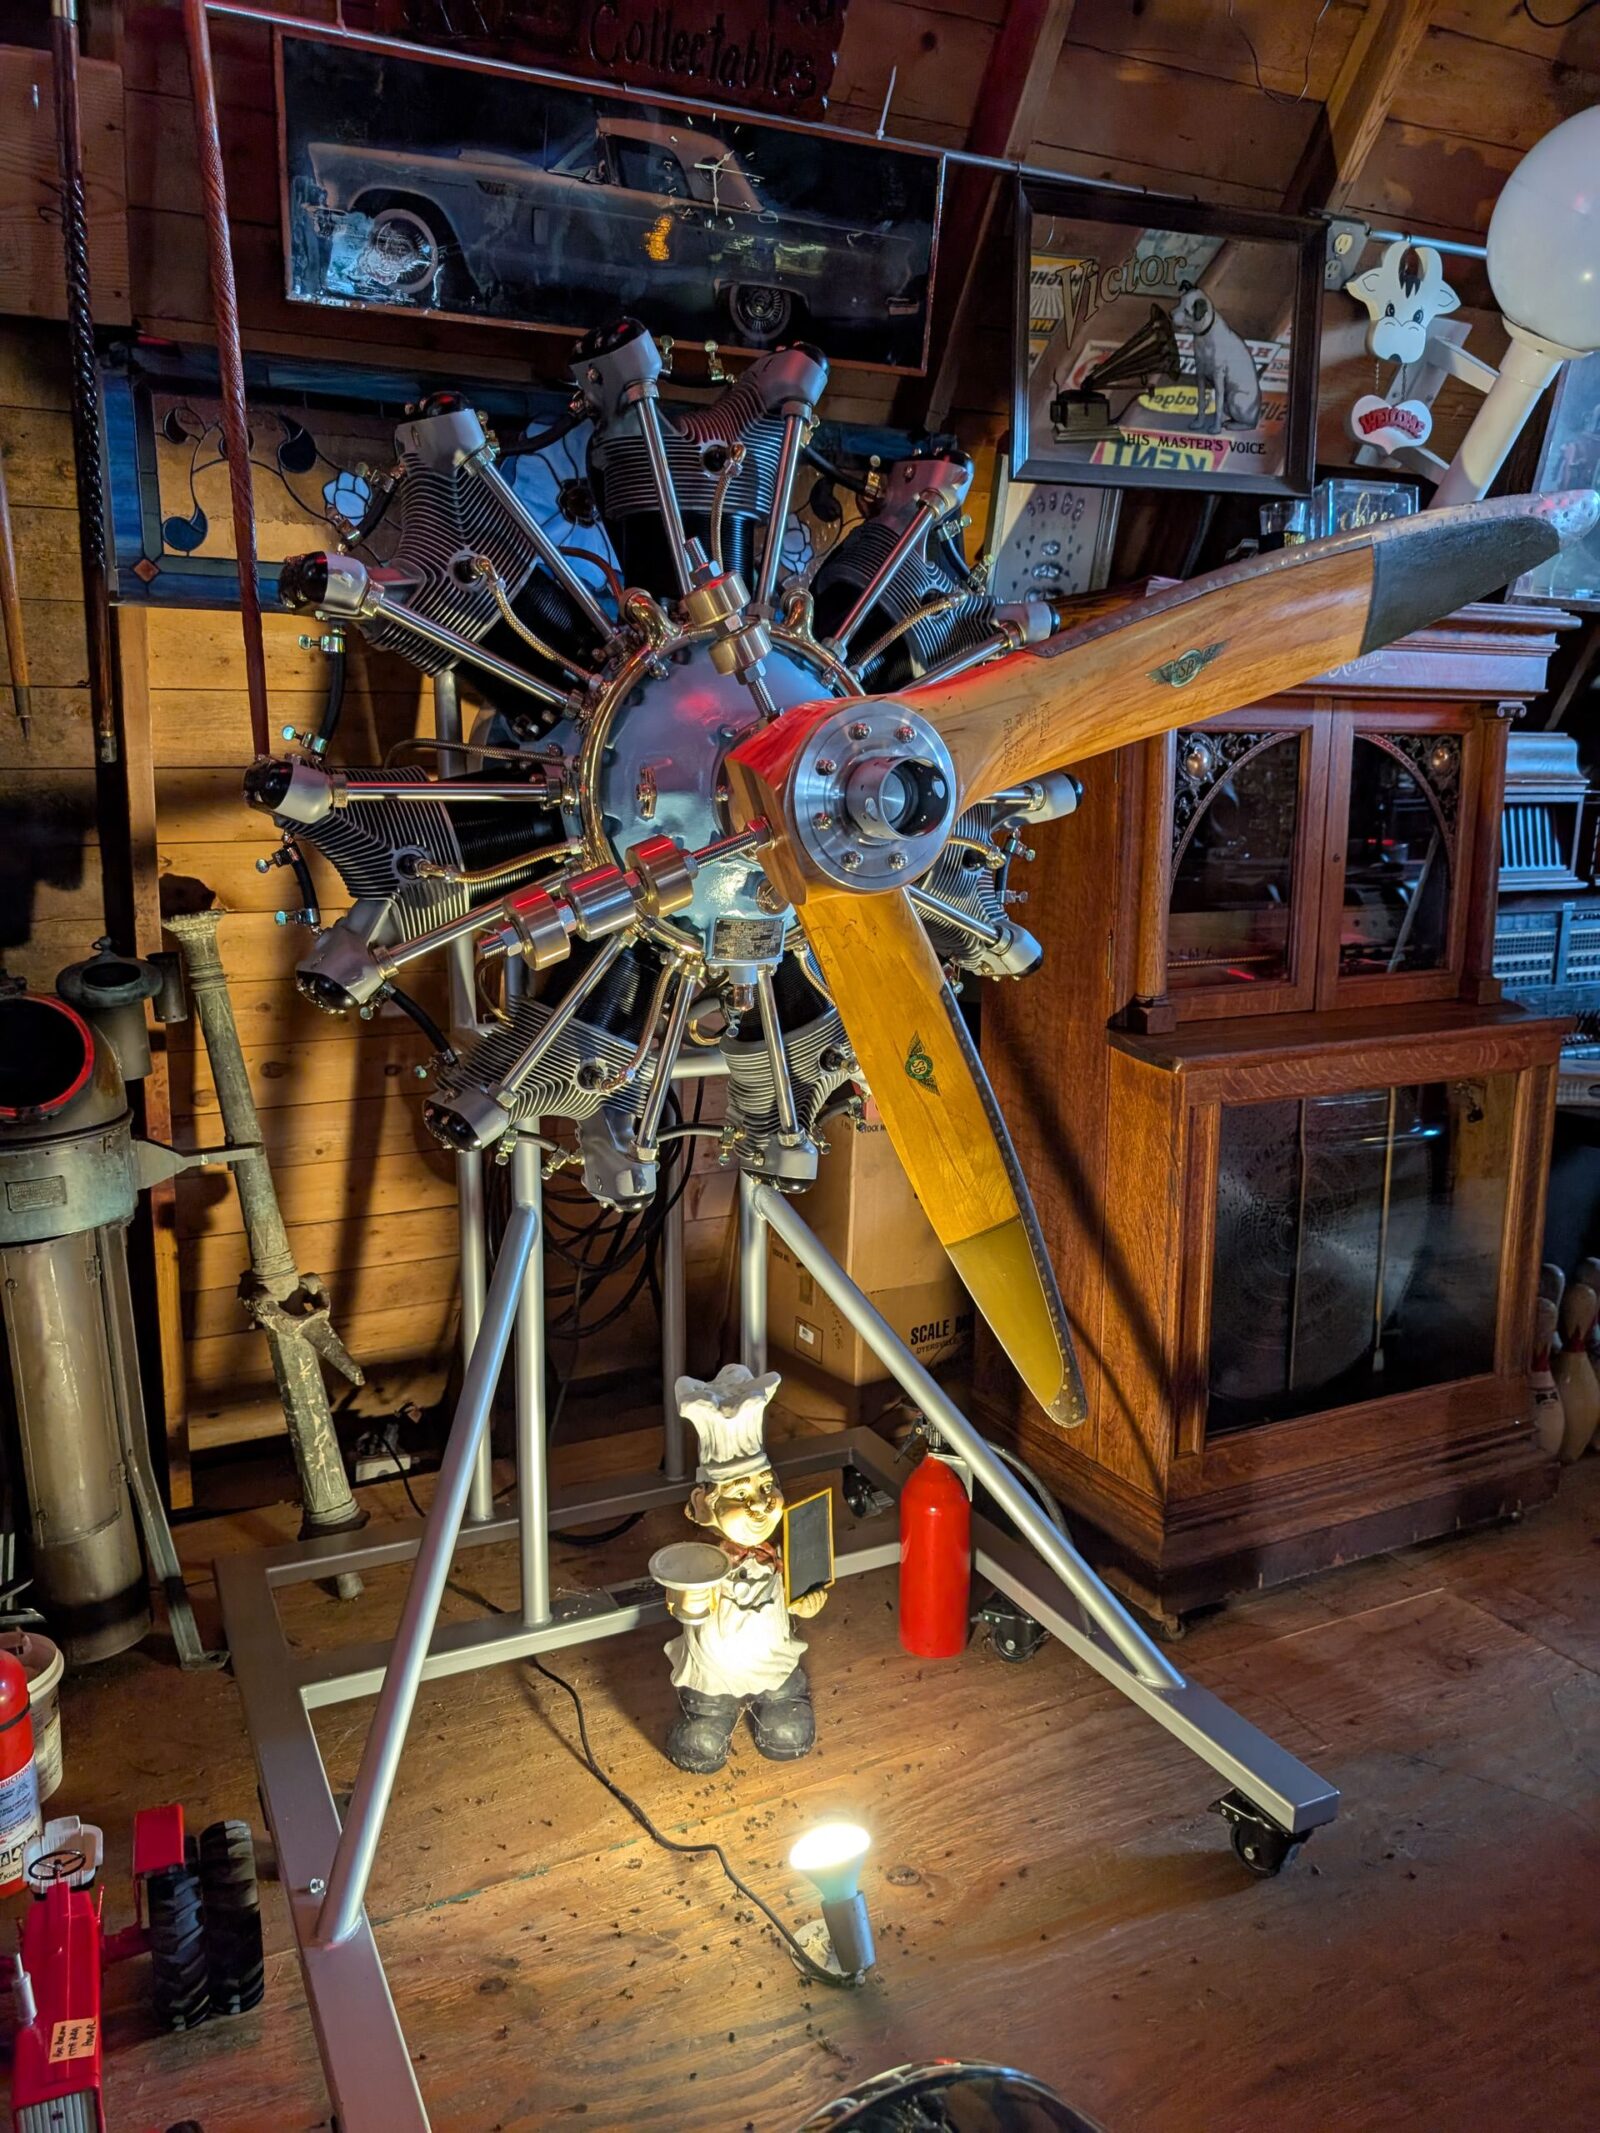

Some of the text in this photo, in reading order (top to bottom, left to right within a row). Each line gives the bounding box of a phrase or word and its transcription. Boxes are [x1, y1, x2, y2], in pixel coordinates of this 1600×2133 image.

[1056, 252, 1187, 350] Victor
[1359, 406, 1425, 439] WELCOME
[1126, 433, 1266, 455] HIS MASTER'S VOICE
[910, 1323, 950, 1346] SCALE
